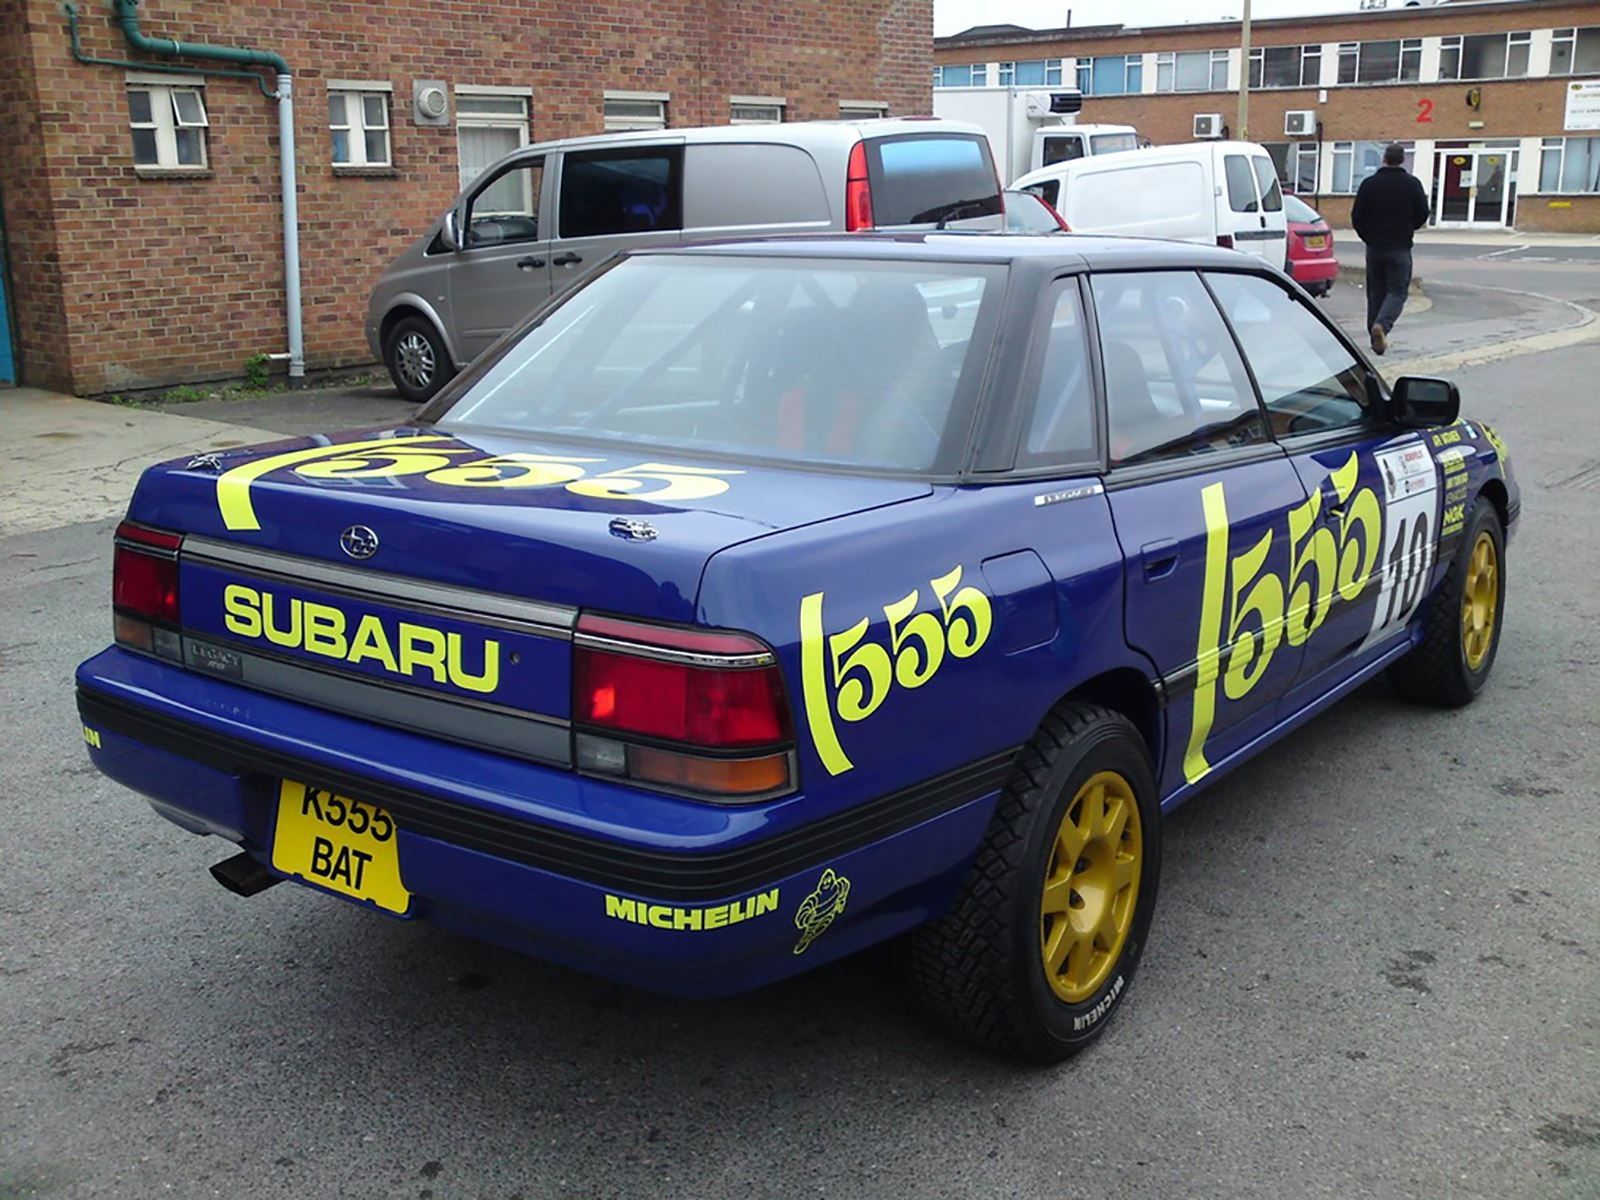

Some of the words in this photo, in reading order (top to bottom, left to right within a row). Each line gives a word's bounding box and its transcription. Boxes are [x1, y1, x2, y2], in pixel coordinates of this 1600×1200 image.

[1416, 98, 1434, 123] 2
[295, 446, 746, 501] 555
[1380, 511, 1428, 630] 10
[223, 584, 500, 693] SUBARU
[829, 564, 993, 722] 555
[301, 785, 394, 842] K555
[310, 835, 373, 891] BAT
[604, 888, 780, 931] MICHELIN
[1073, 975, 1125, 1031] MICHELIN
